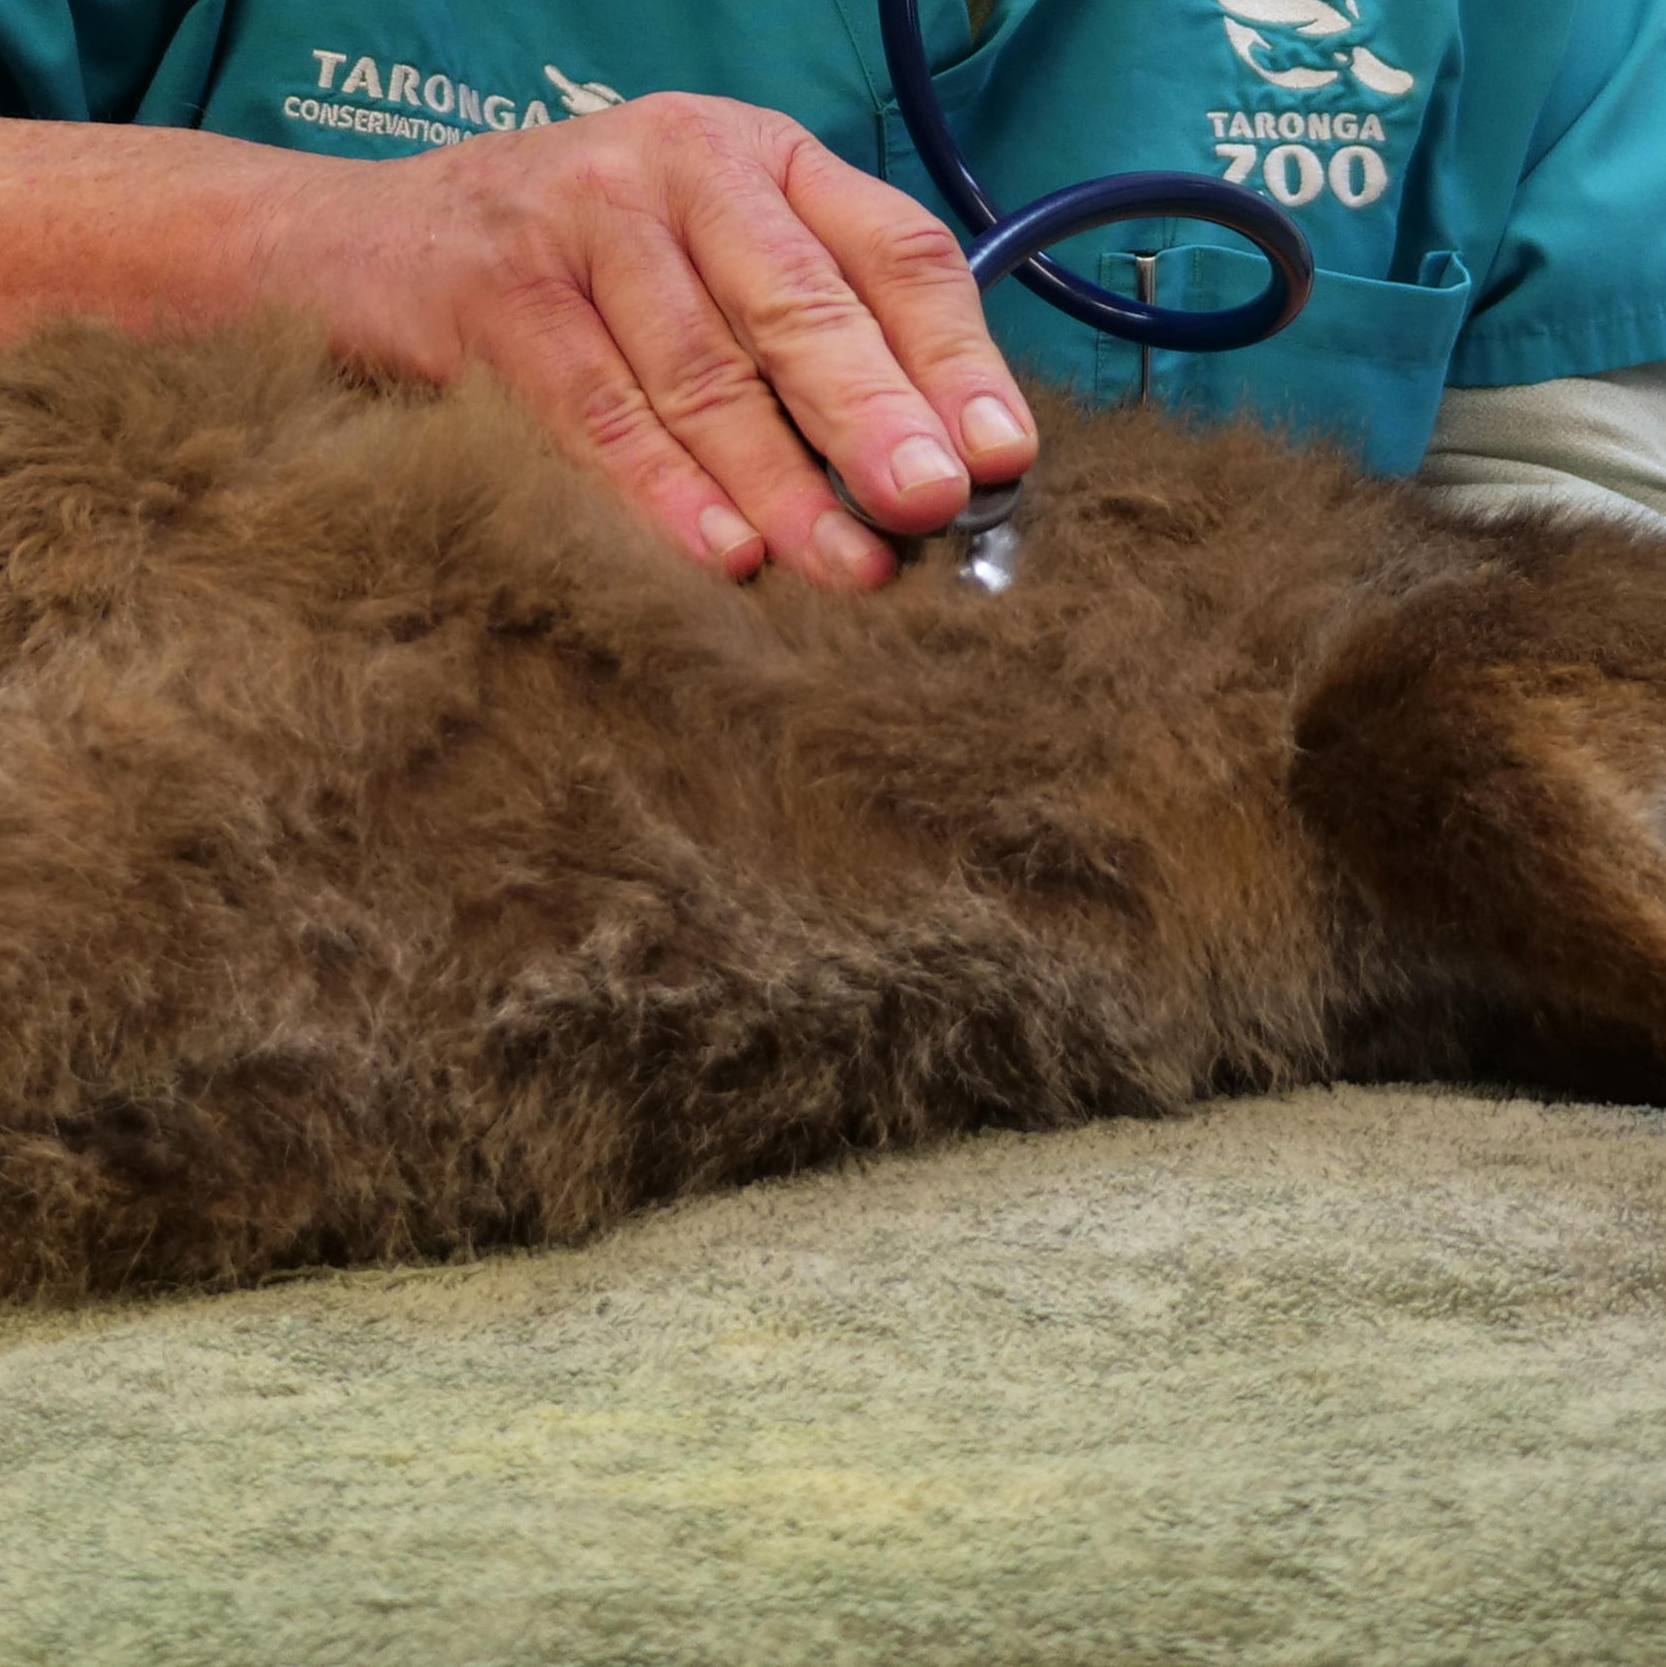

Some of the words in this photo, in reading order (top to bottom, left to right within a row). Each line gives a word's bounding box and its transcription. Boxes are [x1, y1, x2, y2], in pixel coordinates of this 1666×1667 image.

[312, 49, 552, 131] TARONGA
[283, 96, 460, 146] CONSERVATION
[1206, 111, 1386, 142] TARONGA
[1215, 143, 1388, 208] ZOO
